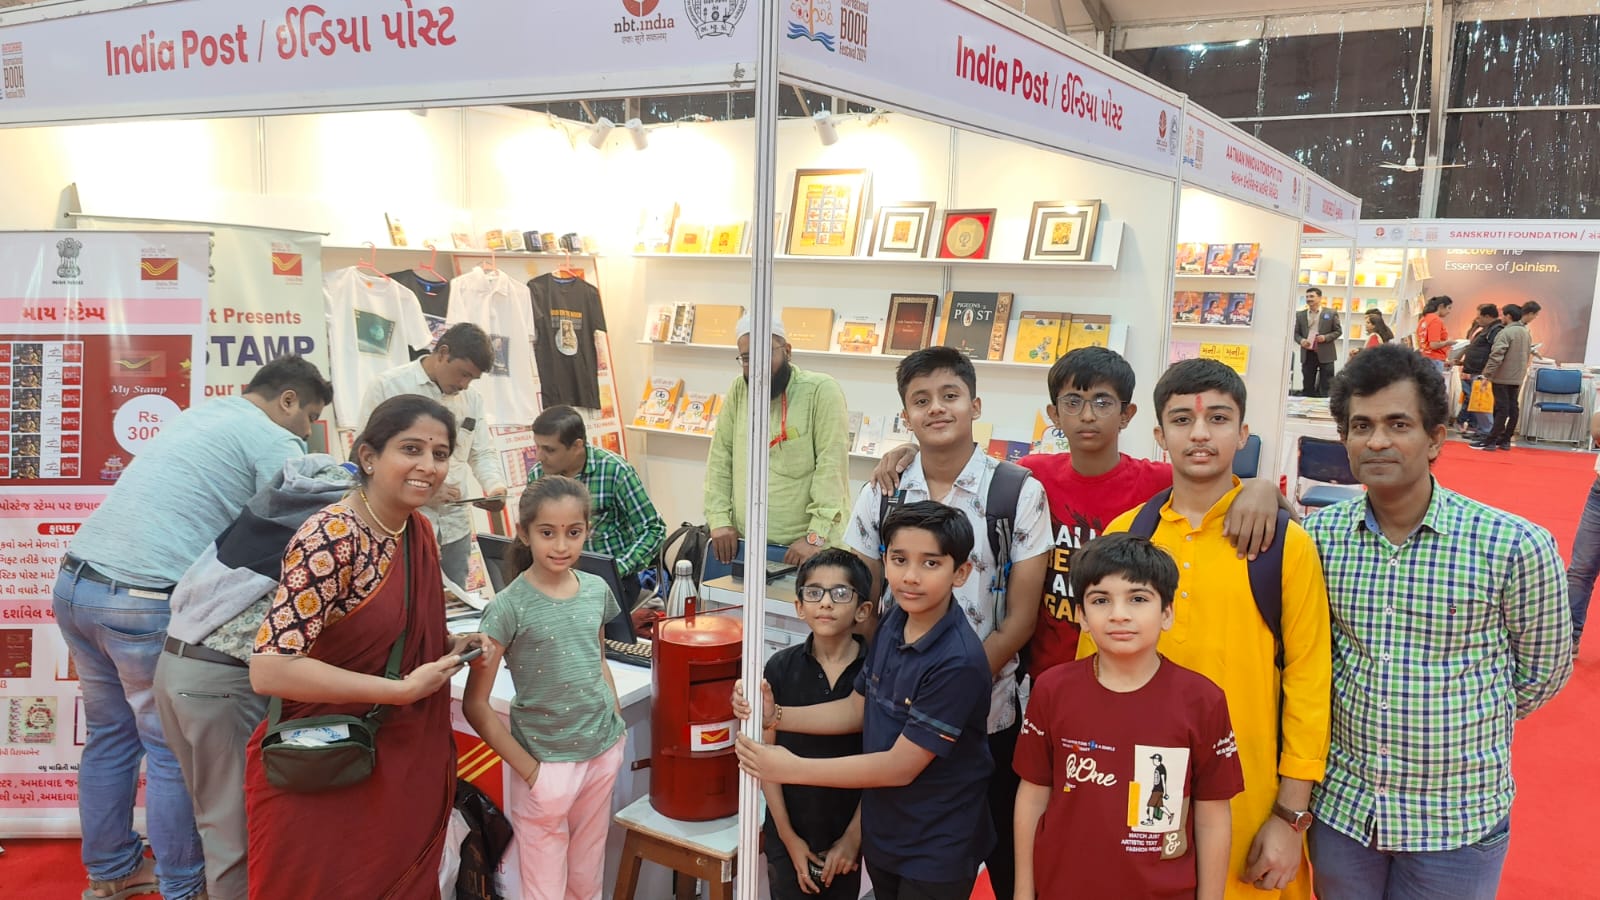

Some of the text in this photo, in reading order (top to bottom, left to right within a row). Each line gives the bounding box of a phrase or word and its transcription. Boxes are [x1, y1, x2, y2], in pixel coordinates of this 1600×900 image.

[276, 0, 457, 60] ઈન્ડિયા પોસ્ટ
[105, 29, 176, 76] India
[181, 24, 249, 69] Post
[956, 35, 1008, 92] India
[1011, 58, 1049, 106] Post
[1061, 72, 1123, 131] ઈન્ડિયા પોસ્ટ
[1449, 230, 1506, 239] SANSKRUTI
[1508, 231, 1578, 240] FOUNDATION
[1445, 260, 1560, 273] Essence of Jainism.
[22, 306, 57, 321] માય
[223, 308, 302, 324] Presents
[206, 336, 314, 367] TAMP
[111, 385, 167, 397] My Stamp
[138, 411, 163, 423] Rs.
